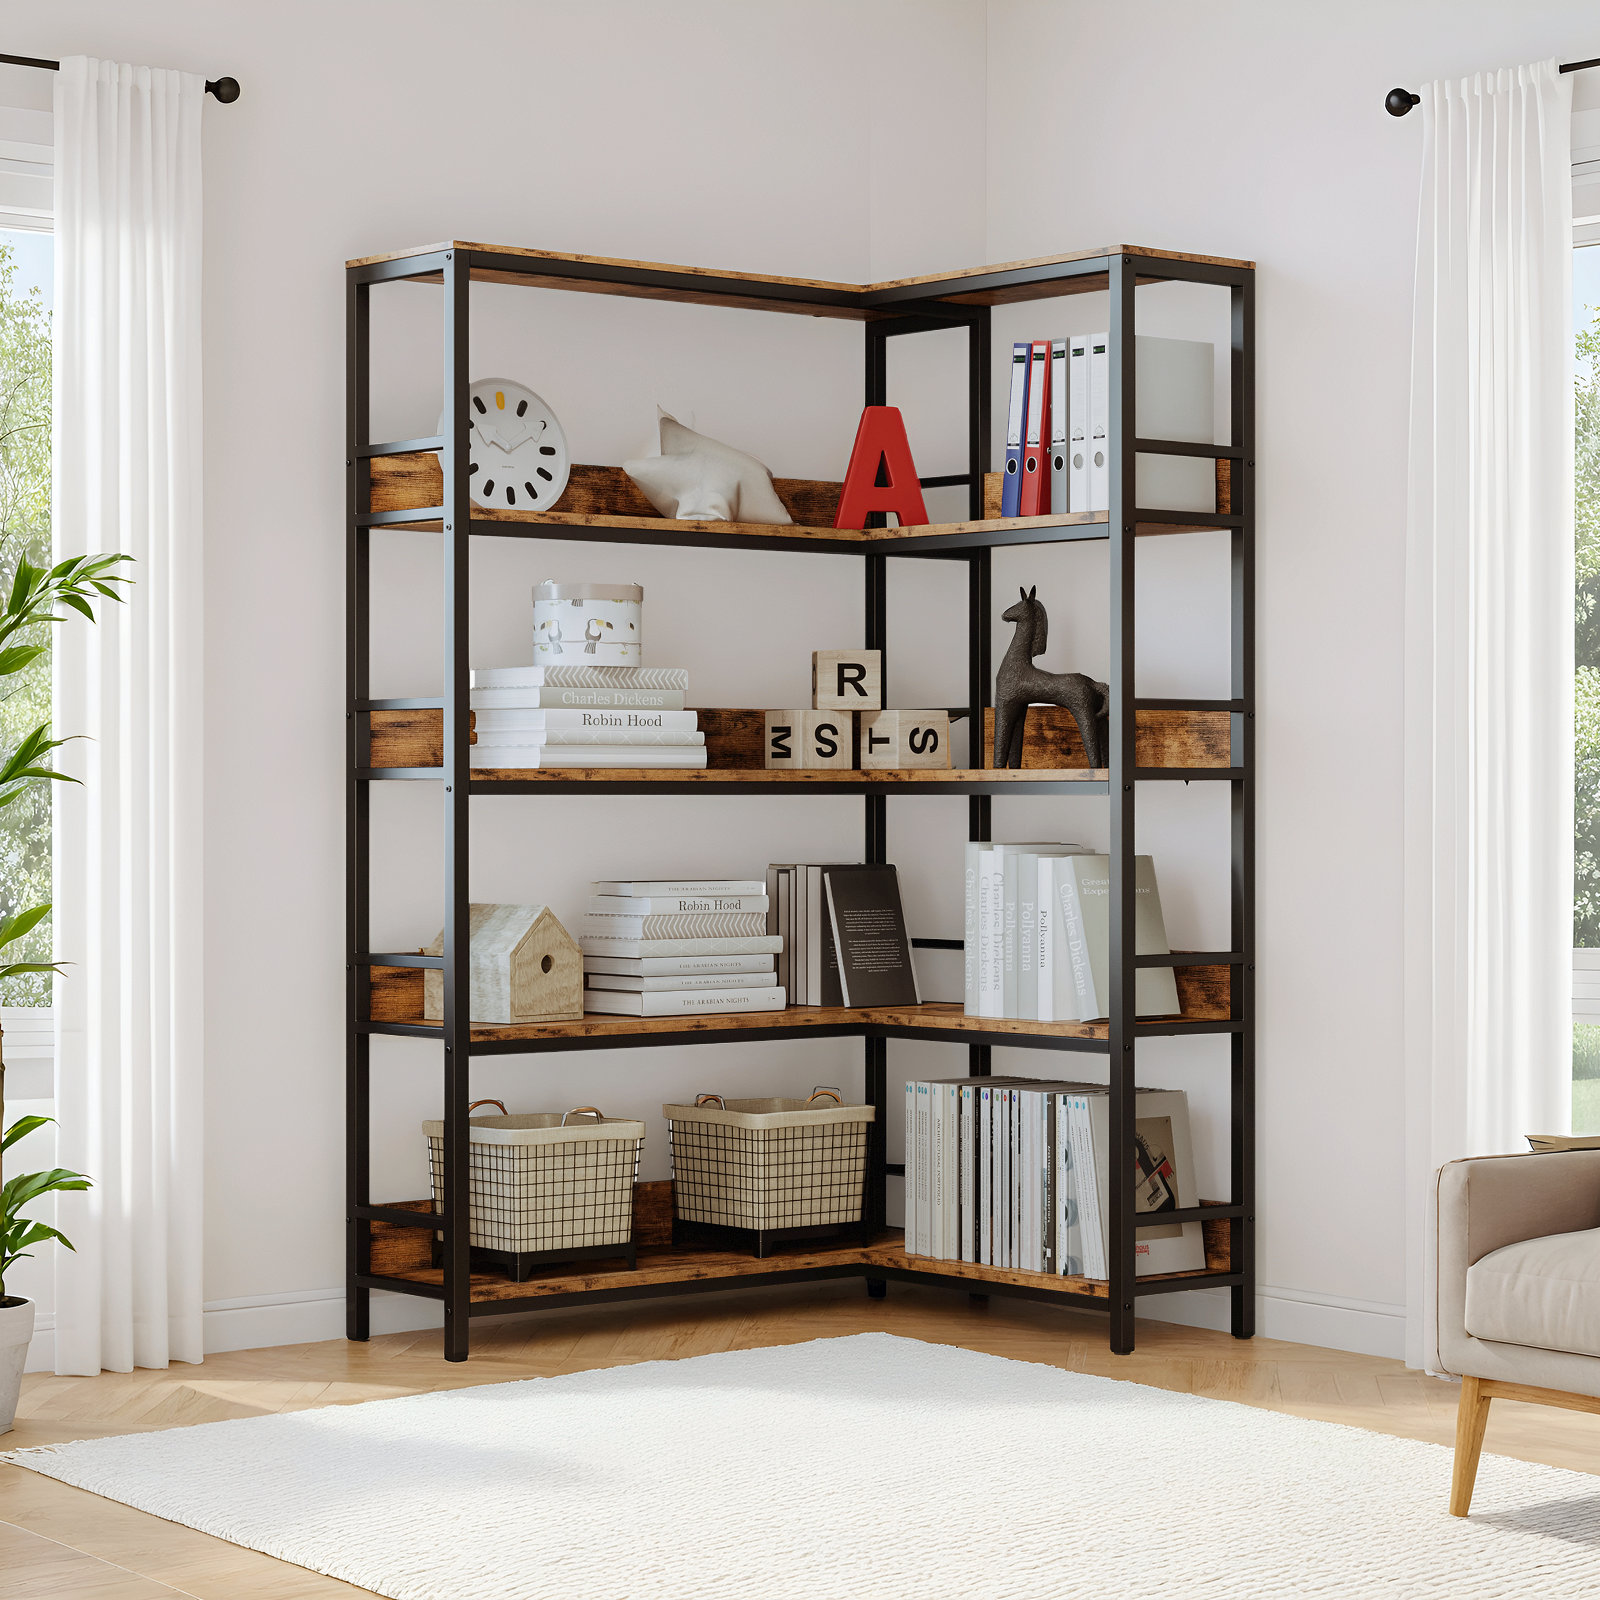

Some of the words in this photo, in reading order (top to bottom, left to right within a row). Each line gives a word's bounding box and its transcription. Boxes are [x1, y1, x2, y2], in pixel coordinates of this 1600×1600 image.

[831, 405, 930, 529] A
[562, 691, 610, 705] Charles
[614, 692, 664, 706] Dickens
[837, 662, 868, 697] R
[582, 713, 622, 727] Robin
[627, 714, 663, 727] Hood
[814, 723, 839, 758] S
[868, 727, 890, 754] T
[908, 727, 939, 754] S
[679, 900, 710, 911] Robin
[714, 899, 742, 910] Hood
[965, 868, 975, 924] Charles
[980, 876, 990, 930] Charles
[1060, 883, 1079, 937] Charles
[965, 930, 975, 990] Dickens
[1005, 902, 1015, 971] Pollyanna
[1020, 901, 1034, 971] Pollyanna
[1039, 910, 1047, 968] Pollyanna
[980, 935, 990, 992] Dickens
[1069, 940, 1087, 996] Dickens
